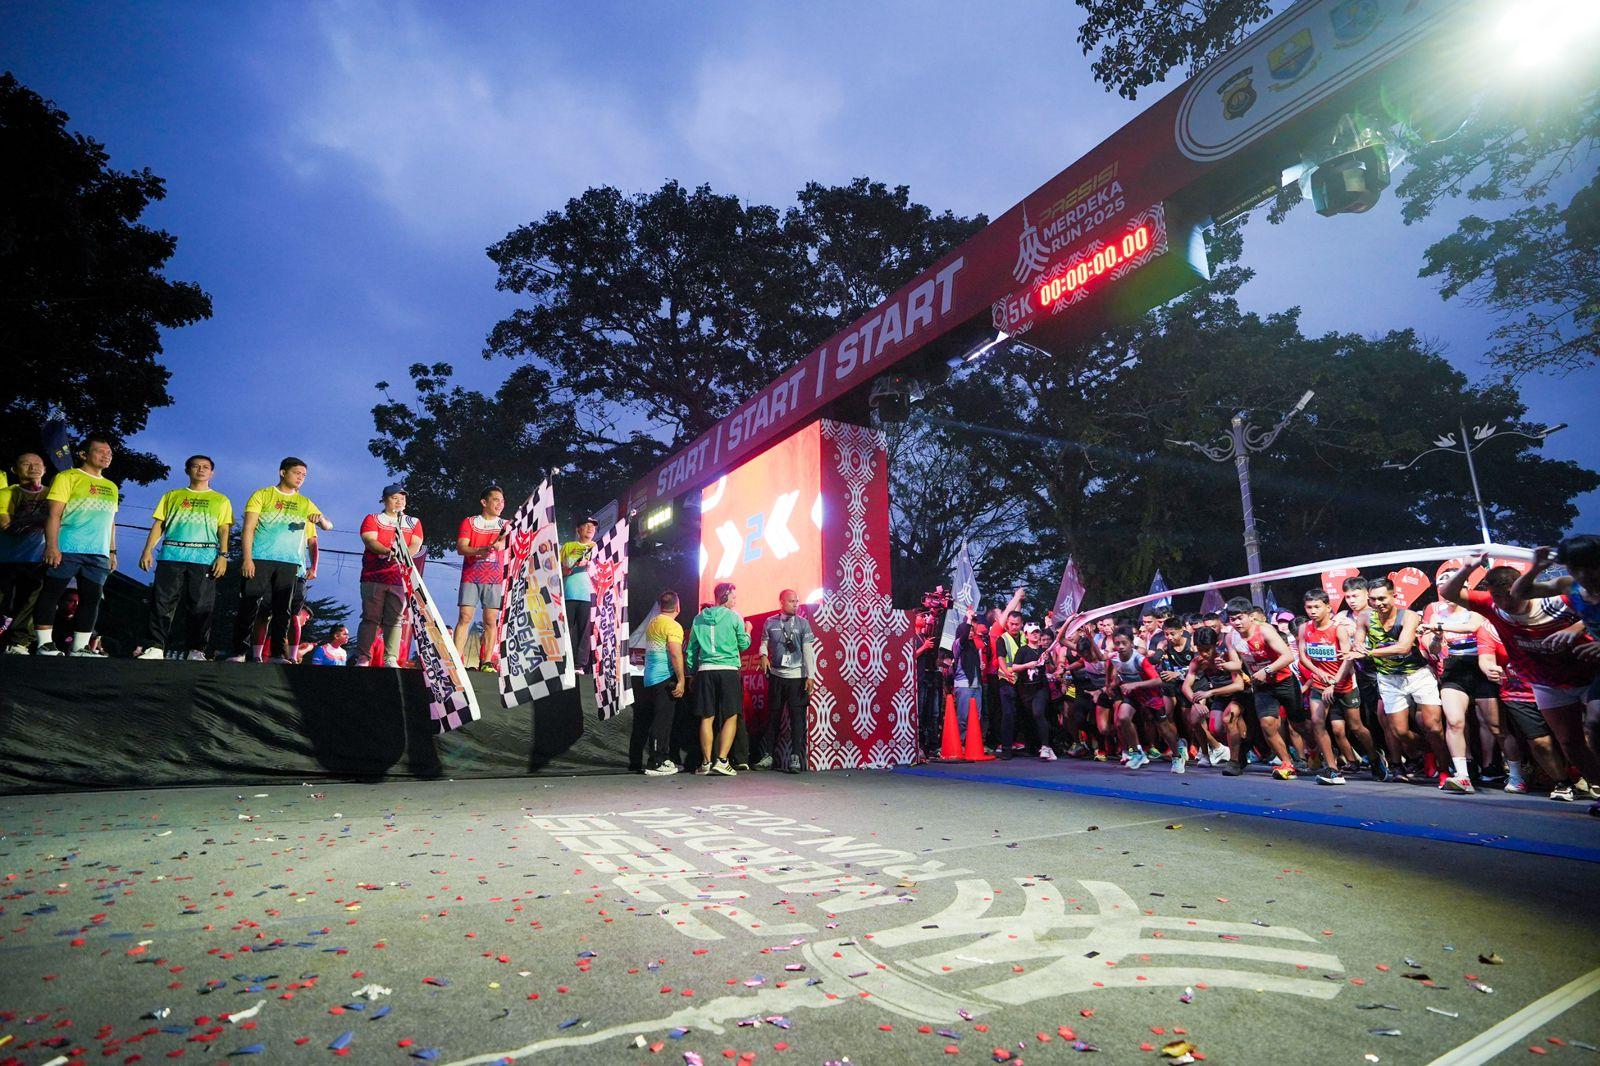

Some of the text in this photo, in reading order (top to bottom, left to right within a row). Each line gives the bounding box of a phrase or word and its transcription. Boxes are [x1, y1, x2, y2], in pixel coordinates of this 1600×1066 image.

[1039, 160, 1119, 223] PRESISI
[1043, 180, 1124, 241] MERDEKA
[1050, 196, 1126, 253] RUN 2025
[1040, 227, 1148, 306] 00:00:00.00
[1009, 292, 1034, 324] 5K
[656, 256, 965, 497] START START START
[743, 511, 764, 565] 2
[506, 621, 525, 677] 2025
[618, 807, 917, 914] MERDEKA
[690, 803, 977, 882] RUN 2025
